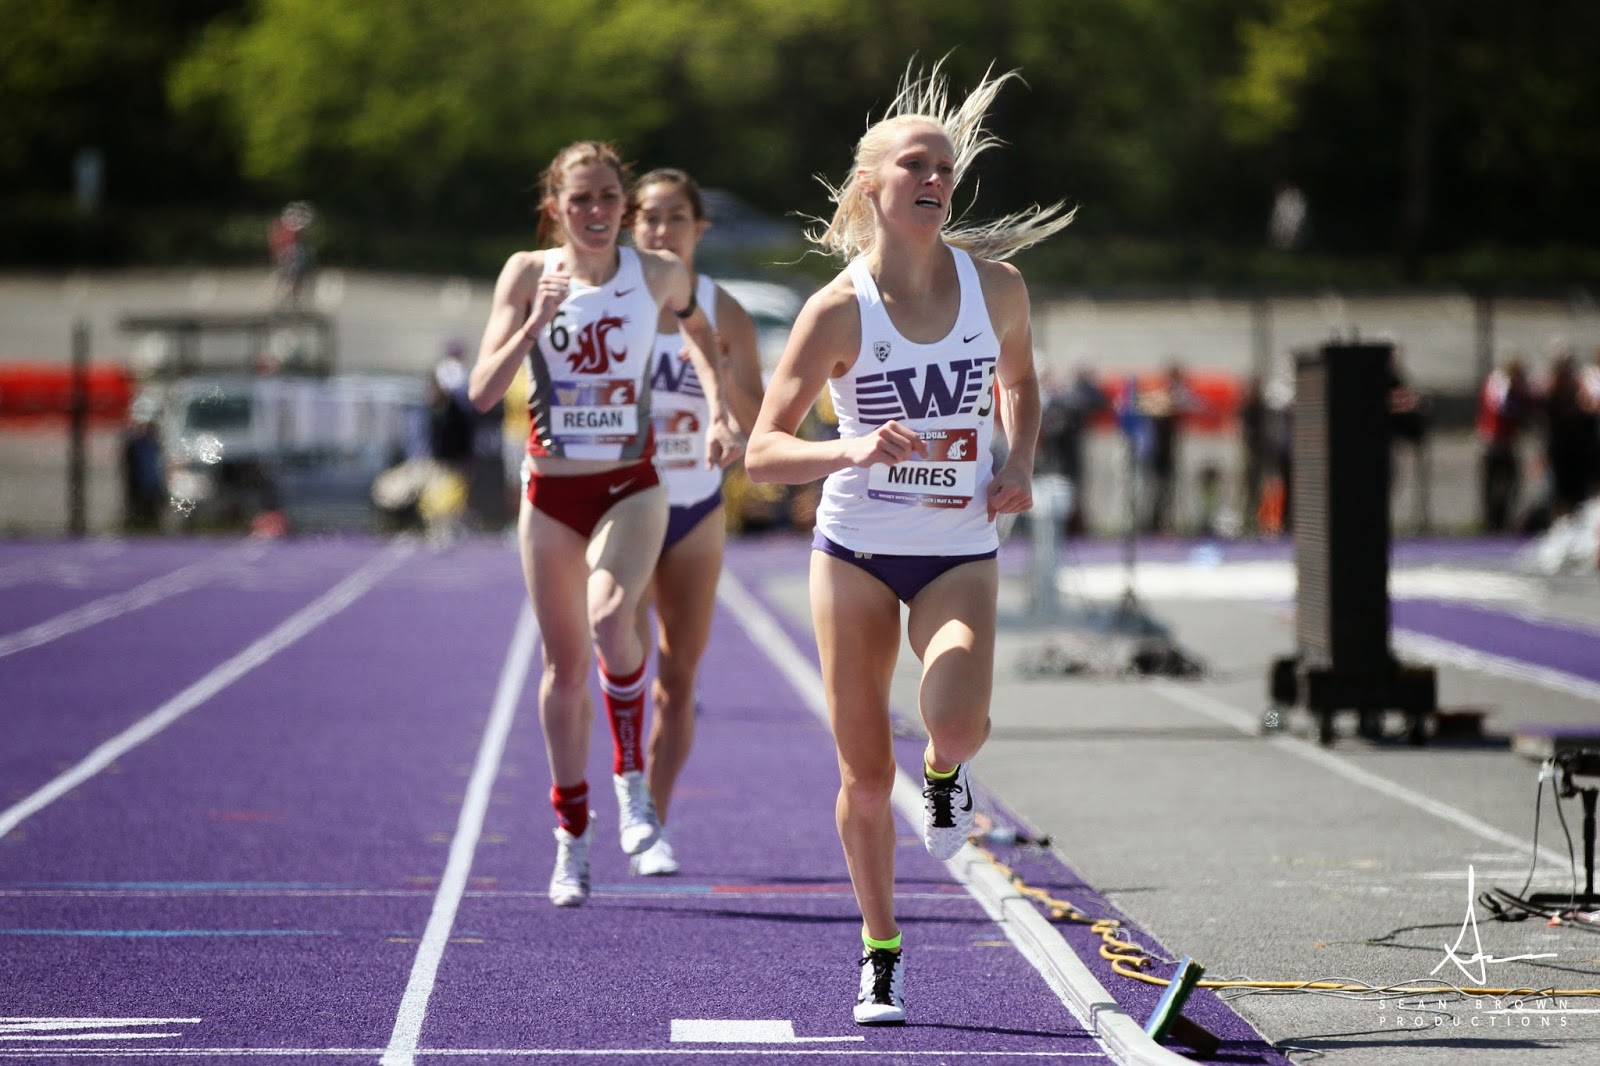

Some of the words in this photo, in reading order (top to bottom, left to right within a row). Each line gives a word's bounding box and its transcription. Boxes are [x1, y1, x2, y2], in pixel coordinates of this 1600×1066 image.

[550, 311, 570, 352] 6
[886, 358, 973, 420] W
[563, 411, 623, 428] REGAN
[926, 431, 948, 440] DUAL
[887, 466, 957, 487] MIRES
